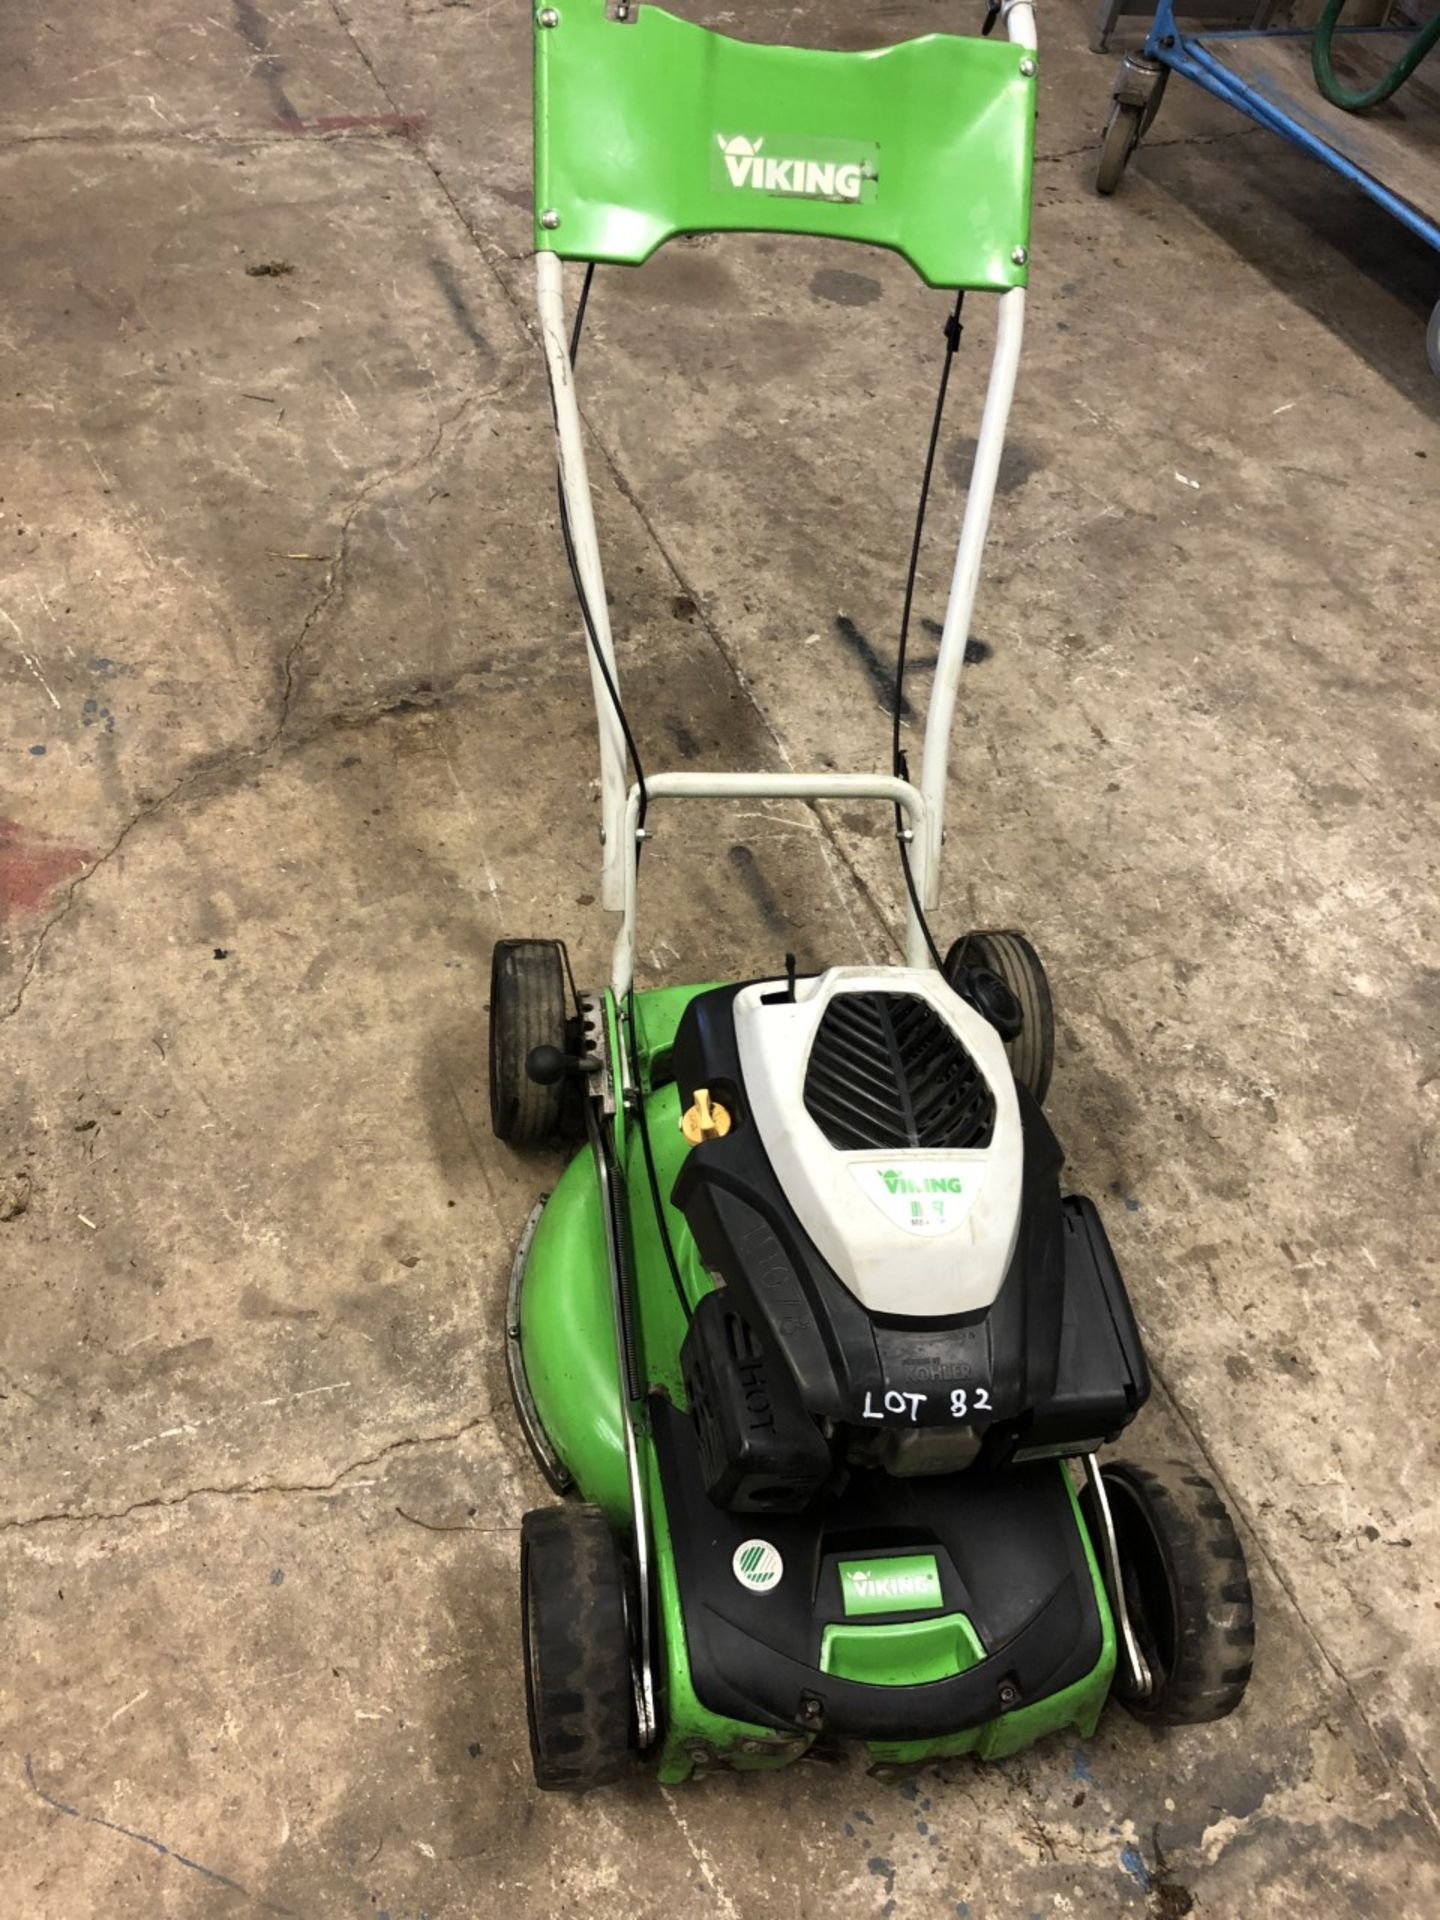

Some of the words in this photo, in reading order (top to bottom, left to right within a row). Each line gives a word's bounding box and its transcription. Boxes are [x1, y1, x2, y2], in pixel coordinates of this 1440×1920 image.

[724, 155, 861, 198] VIKING
[902, 1363, 972, 1381] KOHLER
[862, 1390, 927, 1421] LOT
[950, 1387, 992, 1417] 82
[853, 1575, 930, 1597] VIKING
